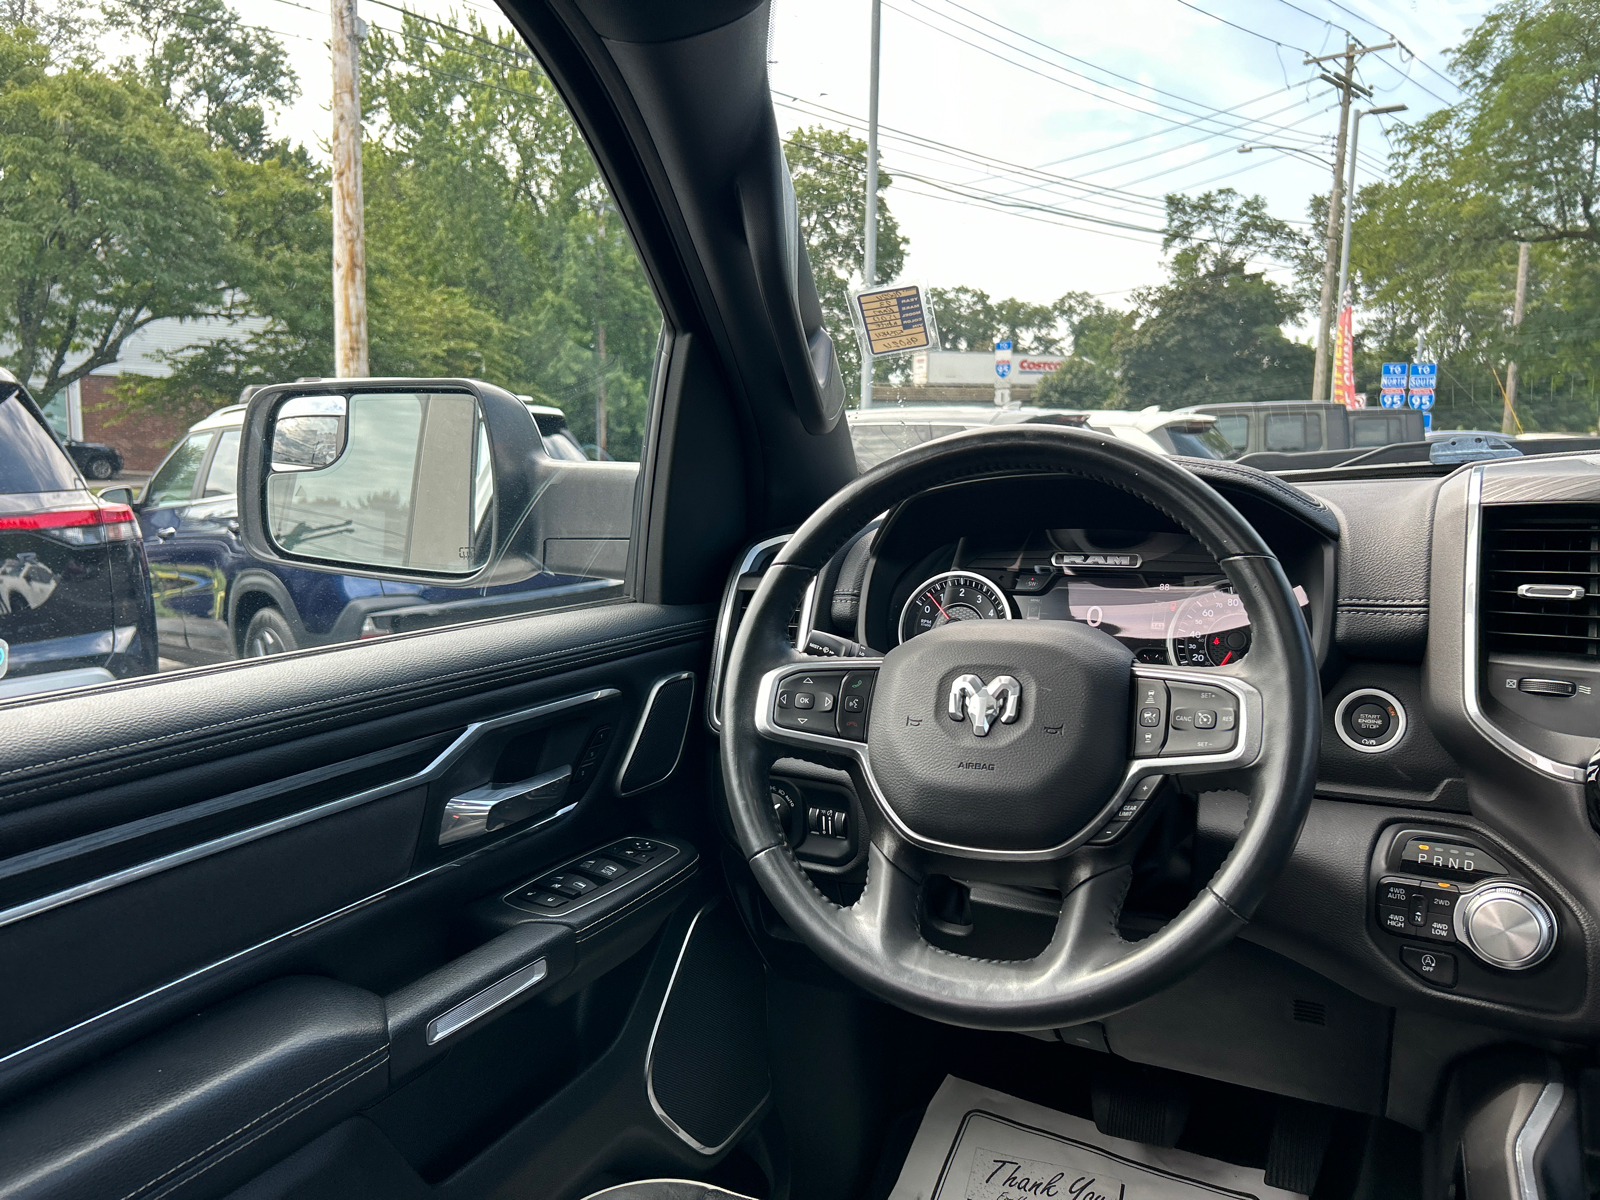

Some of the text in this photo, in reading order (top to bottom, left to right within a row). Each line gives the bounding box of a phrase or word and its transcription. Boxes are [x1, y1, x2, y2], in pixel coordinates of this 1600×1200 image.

[997, 365, 1009, 375] 95
[1389, 365, 1401, 374] TO
[1417, 365, 1430, 375] TO
[1382, 376, 1406, 387] NORTH
[1410, 376, 1436, 387] SOUTH
[1384, 395, 1401, 408] 95
[1412, 395, 1430, 410] 95
[1063, 555, 1130, 565] RAM
[959, 588, 965, 597] 2
[976, 595, 982, 603] 3
[1227, 598, 1238, 606] 80
[988, 609, 994, 617] 4
[1086, 605, 1103, 628] 0
[1202, 609, 1214, 617] 60
[1190, 630, 1201, 638] 40
[1192, 654, 1204, 662] 20
[958, 762, 995, 771] AIRBAG
[1418, 854, 1474, 871] P R N D
[1388, 886, 1405, 894] 4WD
[1434, 898, 1450, 906] 2WD
[1388, 914, 1405, 922] 4WD
[1387, 920, 1404, 928] HIGH
[1432, 922, 1448, 930] 4WD
[1432, 928, 1448, 936] LOW
[986, 1159, 1065, 1198] Thank
